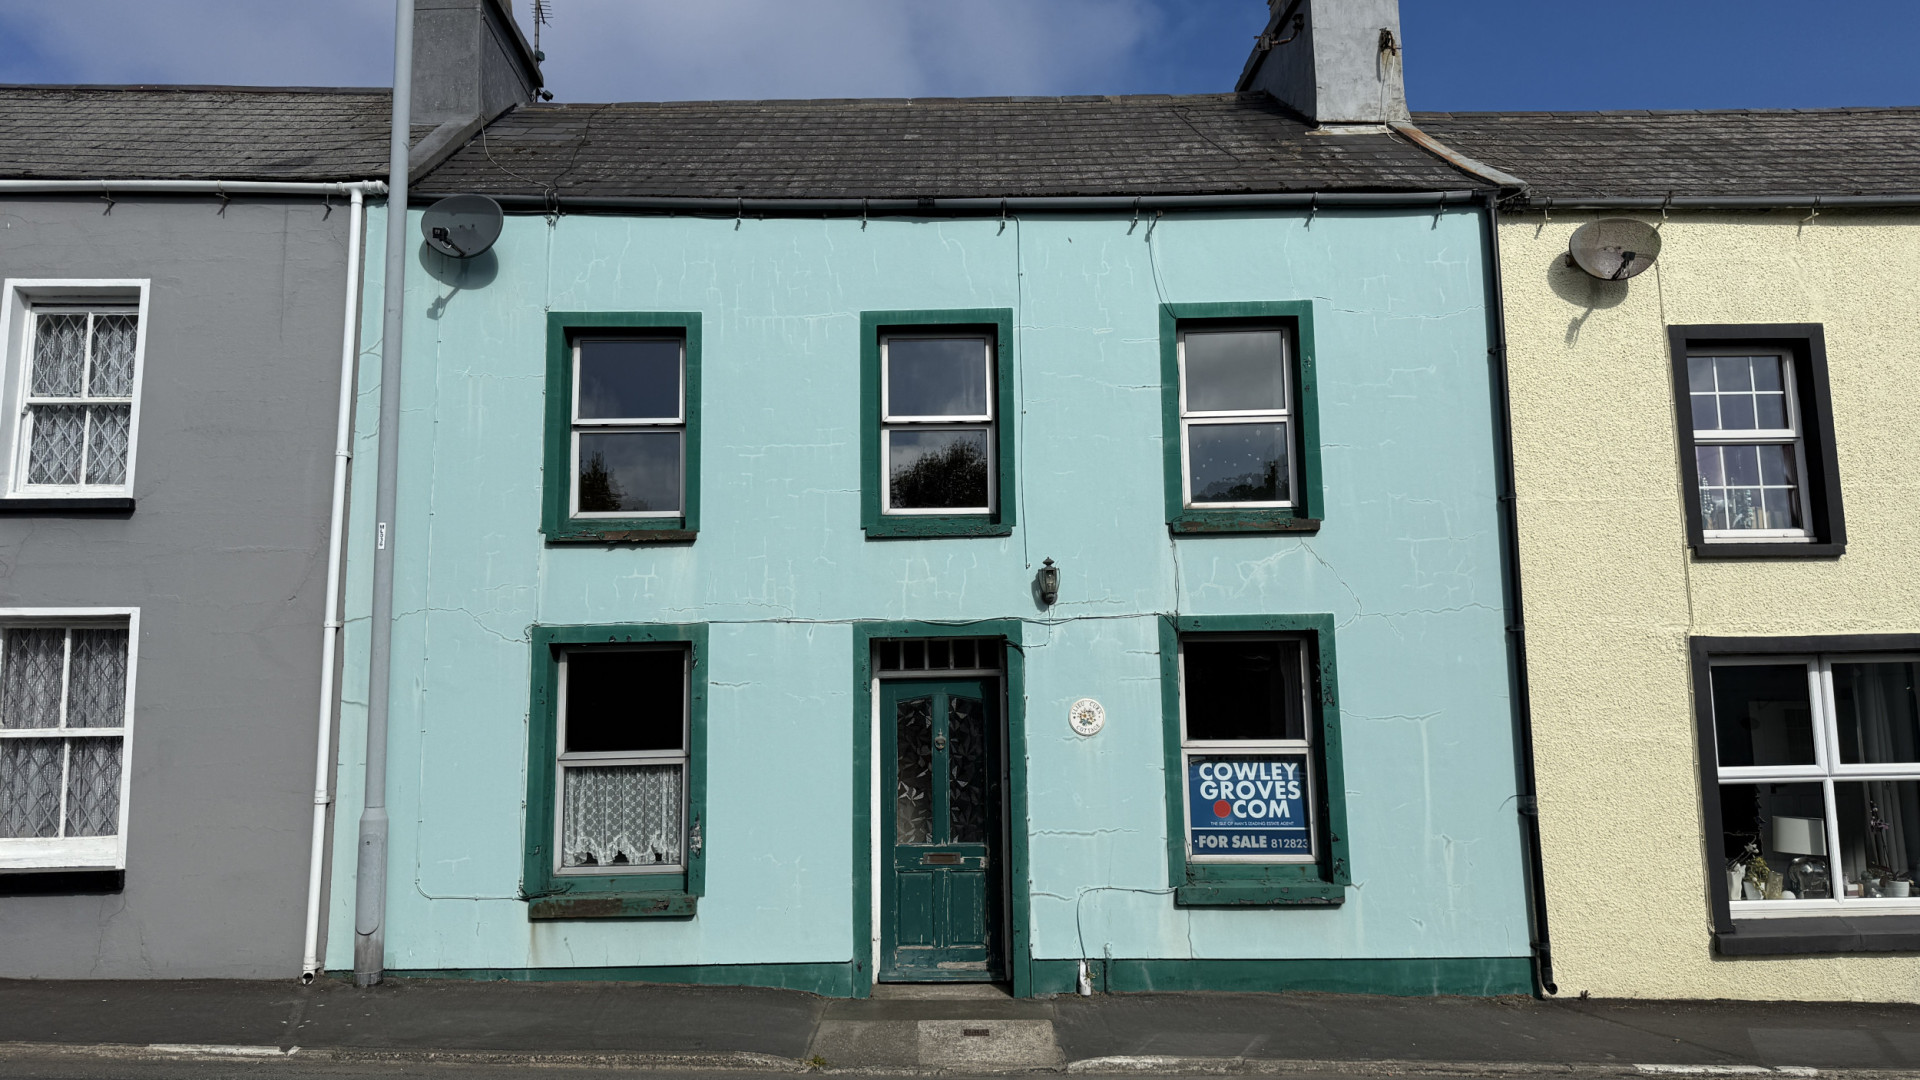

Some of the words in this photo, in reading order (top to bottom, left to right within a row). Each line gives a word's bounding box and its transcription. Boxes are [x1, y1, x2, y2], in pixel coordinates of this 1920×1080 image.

[1076, 723, 1100, 733] COTTAGE
[1199, 762, 1298, 780] COWLEY
[1200, 780, 1300, 800] GROVES
[1198, 835, 1228, 848] FOR
[1232, 835, 1267, 848] SALE
